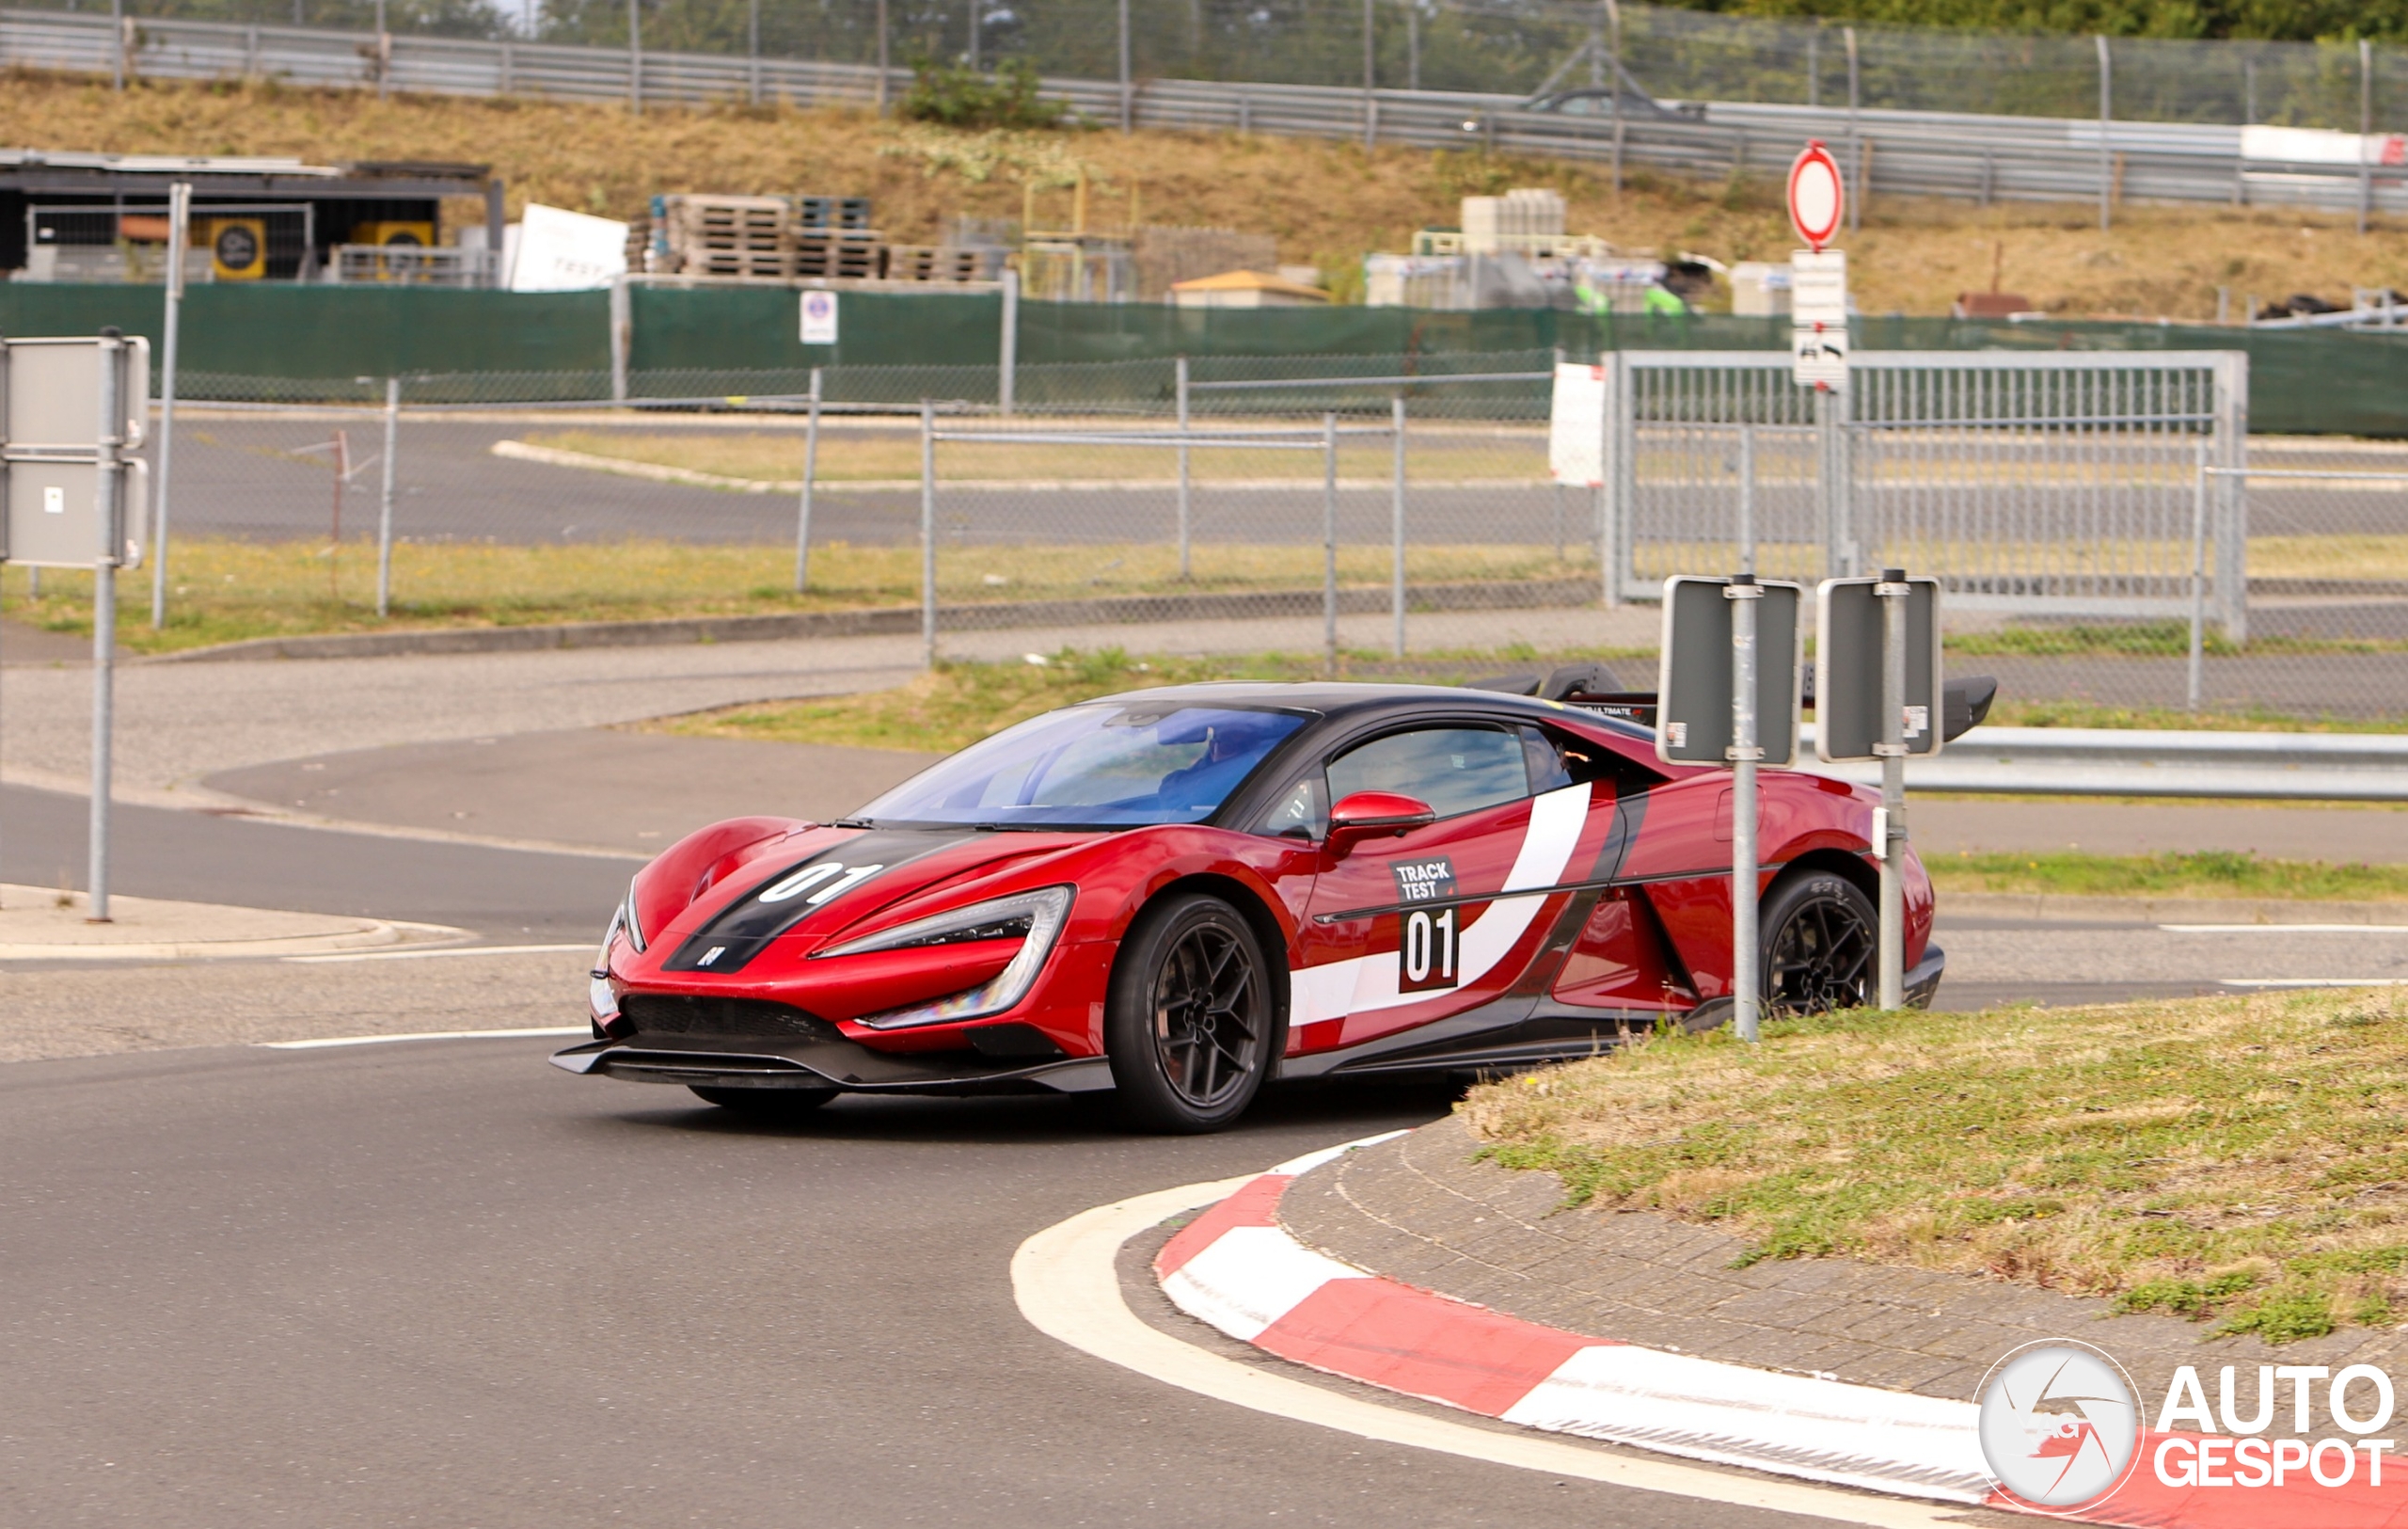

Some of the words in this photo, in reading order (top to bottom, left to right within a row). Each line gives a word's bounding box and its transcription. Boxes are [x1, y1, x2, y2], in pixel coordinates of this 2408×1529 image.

[758, 862, 884, 904] 01
[1396, 862, 1450, 883] TRACK
[1402, 881, 1436, 900] TEST
[1406, 908, 1453, 982] 01
